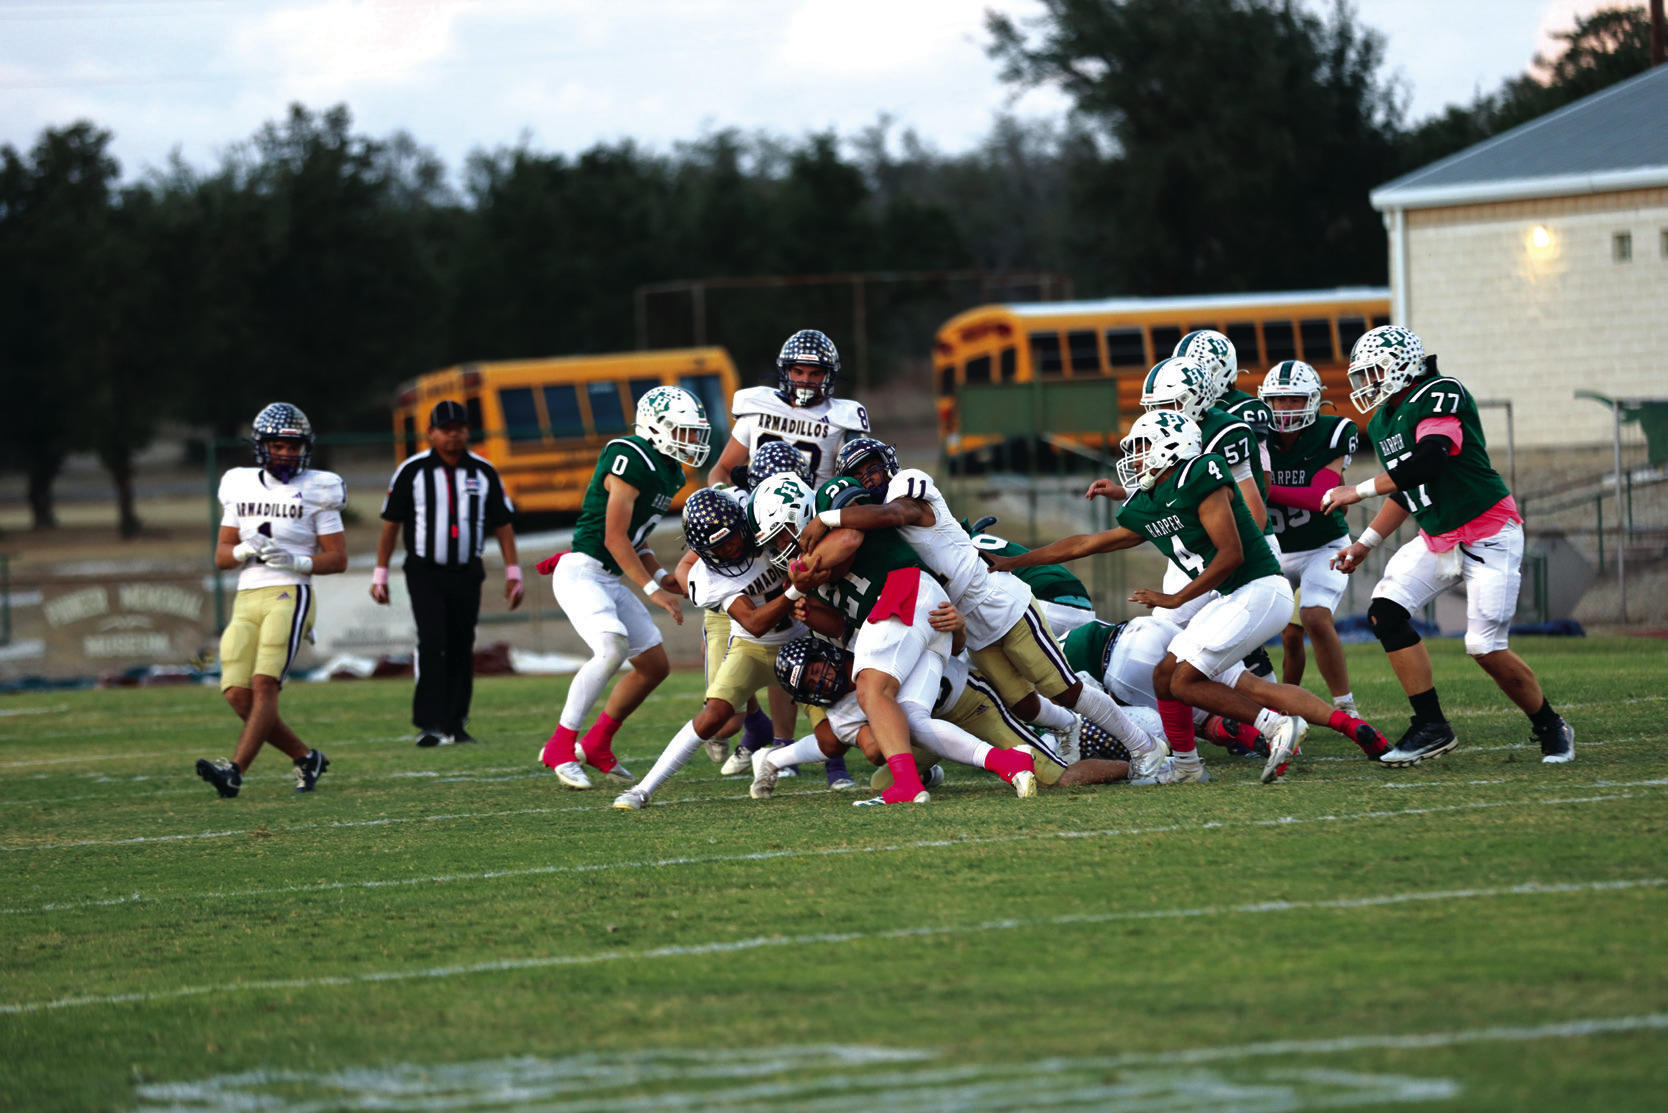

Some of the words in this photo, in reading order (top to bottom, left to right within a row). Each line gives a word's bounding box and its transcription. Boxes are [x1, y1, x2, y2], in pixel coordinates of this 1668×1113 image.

[1431, 392, 1460, 413] 77
[758, 413, 829, 439] ARMADILLOS
[857, 406, 869, 430] 8
[1224, 436, 1251, 465] 57
[1379, 432, 1406, 457] HARPER
[611, 454, 629, 476] 0
[1207, 460, 1224, 480] 4
[906, 477, 927, 500] 11
[1271, 469, 1306, 485] ARPER
[236, 502, 304, 519] ARMADILLOS
[1145, 514, 1185, 539] HARPER
[1170, 533, 1206, 576] 4
